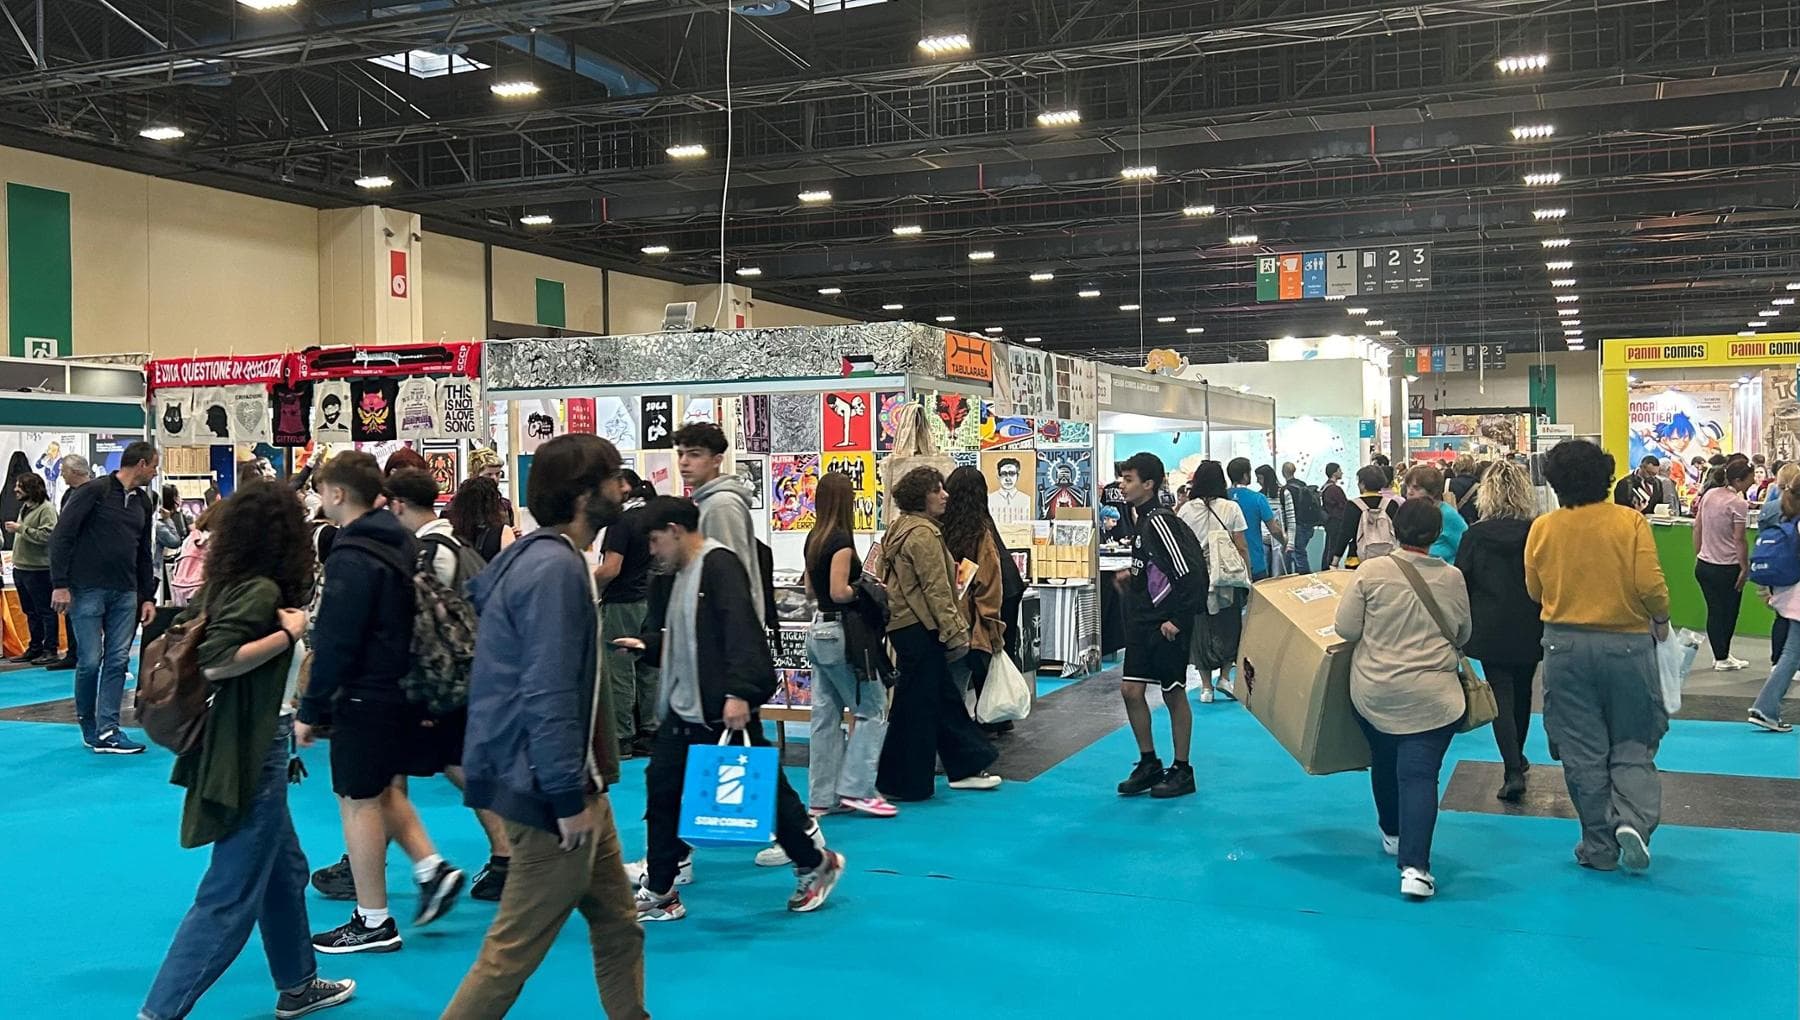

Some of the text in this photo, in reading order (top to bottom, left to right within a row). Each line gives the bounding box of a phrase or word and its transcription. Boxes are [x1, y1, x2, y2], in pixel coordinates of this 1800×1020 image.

[1336, 253, 1347, 270] 1
[1388, 250, 1401, 267] 2
[1413, 248, 1425, 265] 3
[457, 344, 467, 371] CCCP
[1450, 347, 1457, 356] 1
[1495, 345, 1503, 355] 3
[1663, 344, 1704, 359] COMICS
[162, 363, 180, 382] UNA
[181, 360, 232, 383] QUESTIONE
[232, 360, 243, 379] DI
[951, 363, 989, 377] TABULARASA
[443, 384, 472, 399] THIS
[444, 399, 454, 411] IS
[445, 411, 475, 420] A LOVE
[445, 420, 475, 432] SONG
